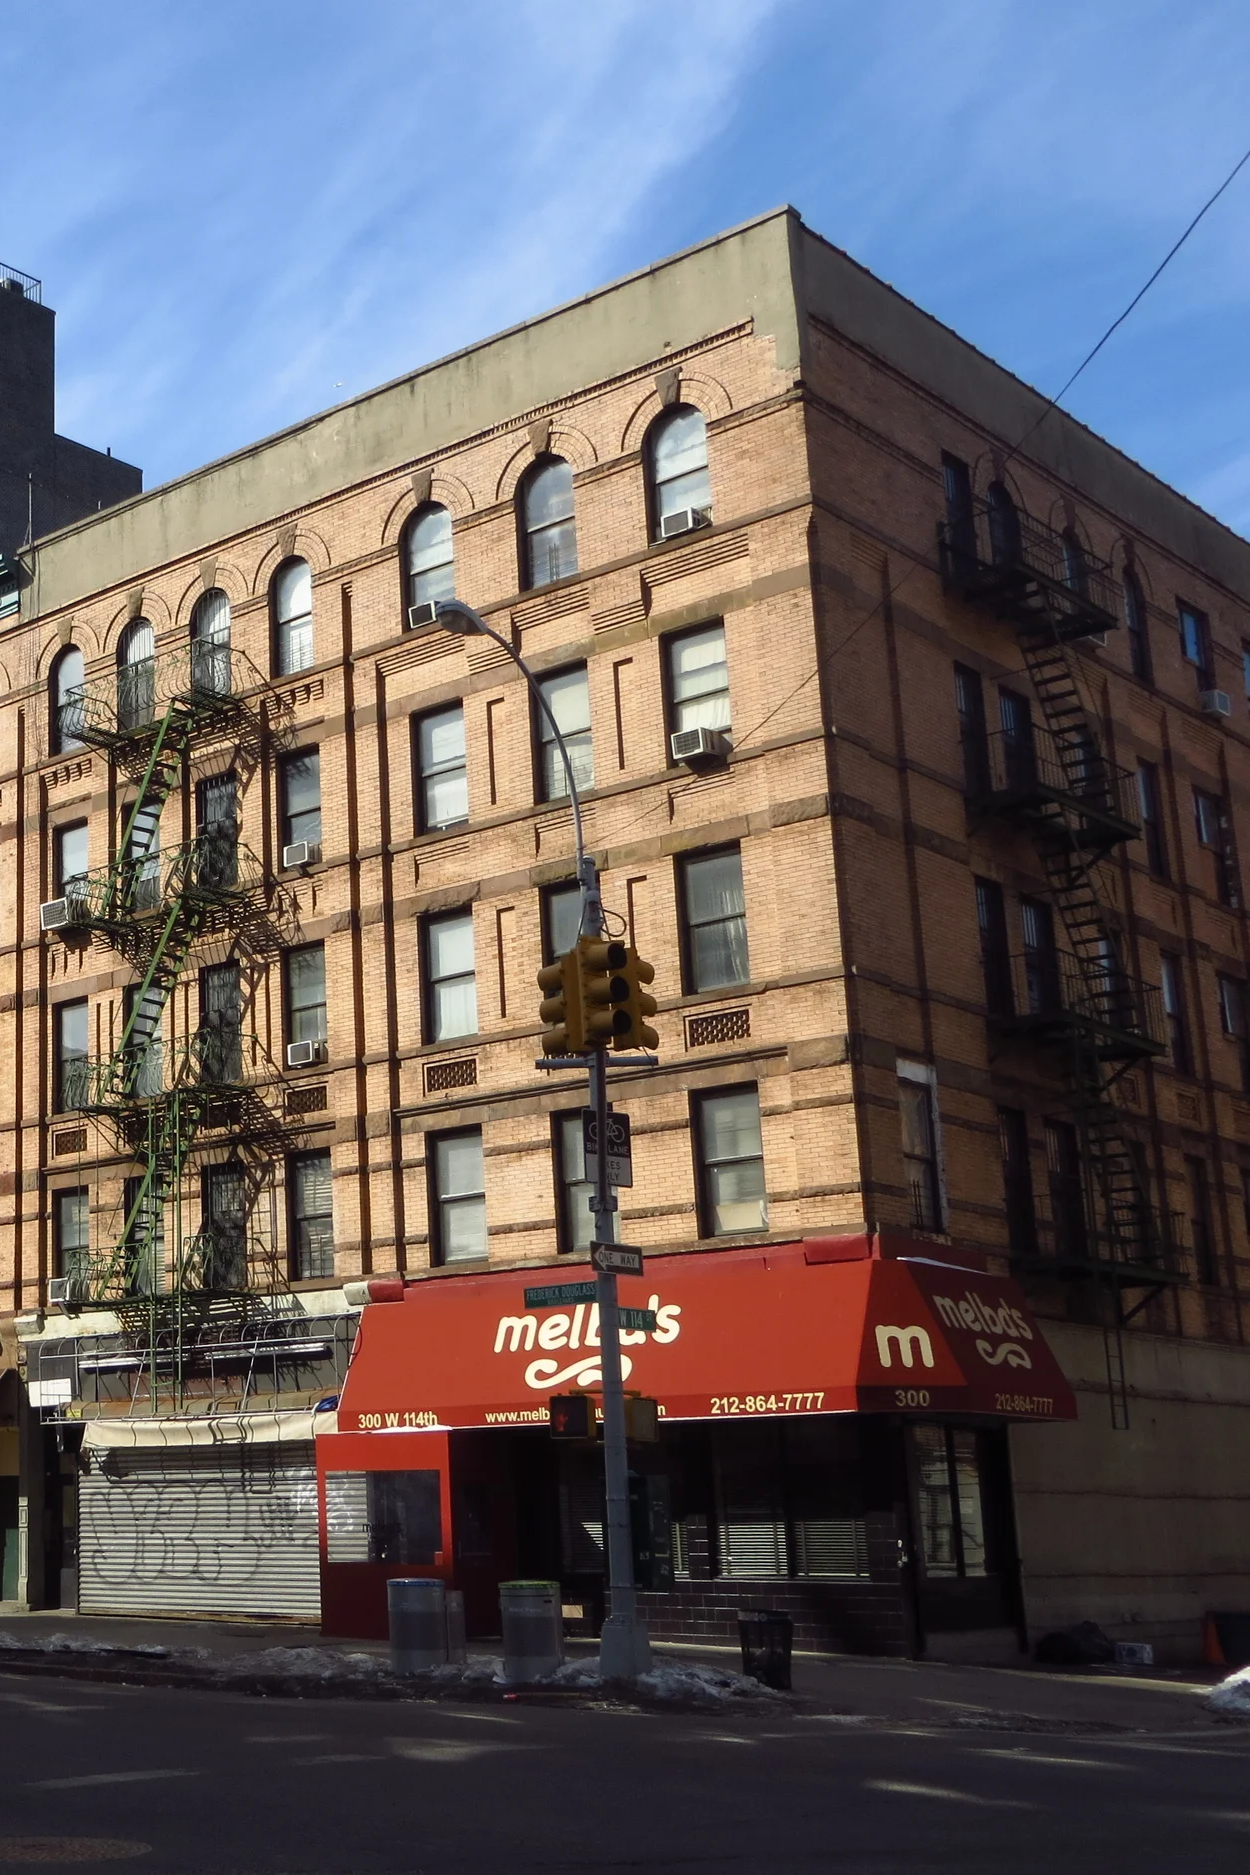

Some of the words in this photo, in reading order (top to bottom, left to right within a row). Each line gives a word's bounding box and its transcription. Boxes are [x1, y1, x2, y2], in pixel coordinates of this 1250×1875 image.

[608, 1145, 630, 1155] LANE
[600, 1251, 614, 1265] ONE
[620, 1252, 637, 1267] WAY
[526, 1286, 559, 1301] FREDERICK
[561, 1282, 595, 1298] DOUGLASS
[619, 1309, 627, 1326] W
[630, 1312, 643, 1328] 114
[710, 1392, 825, 1414] 212-864-7777
[895, 1389, 930, 1407] 300
[995, 1393, 1054, 1414] 212-864-7777
[358, 1413, 382, 1429] 300
[384, 1412, 400, 1428] W
[402, 1410, 438, 1427] 114th
